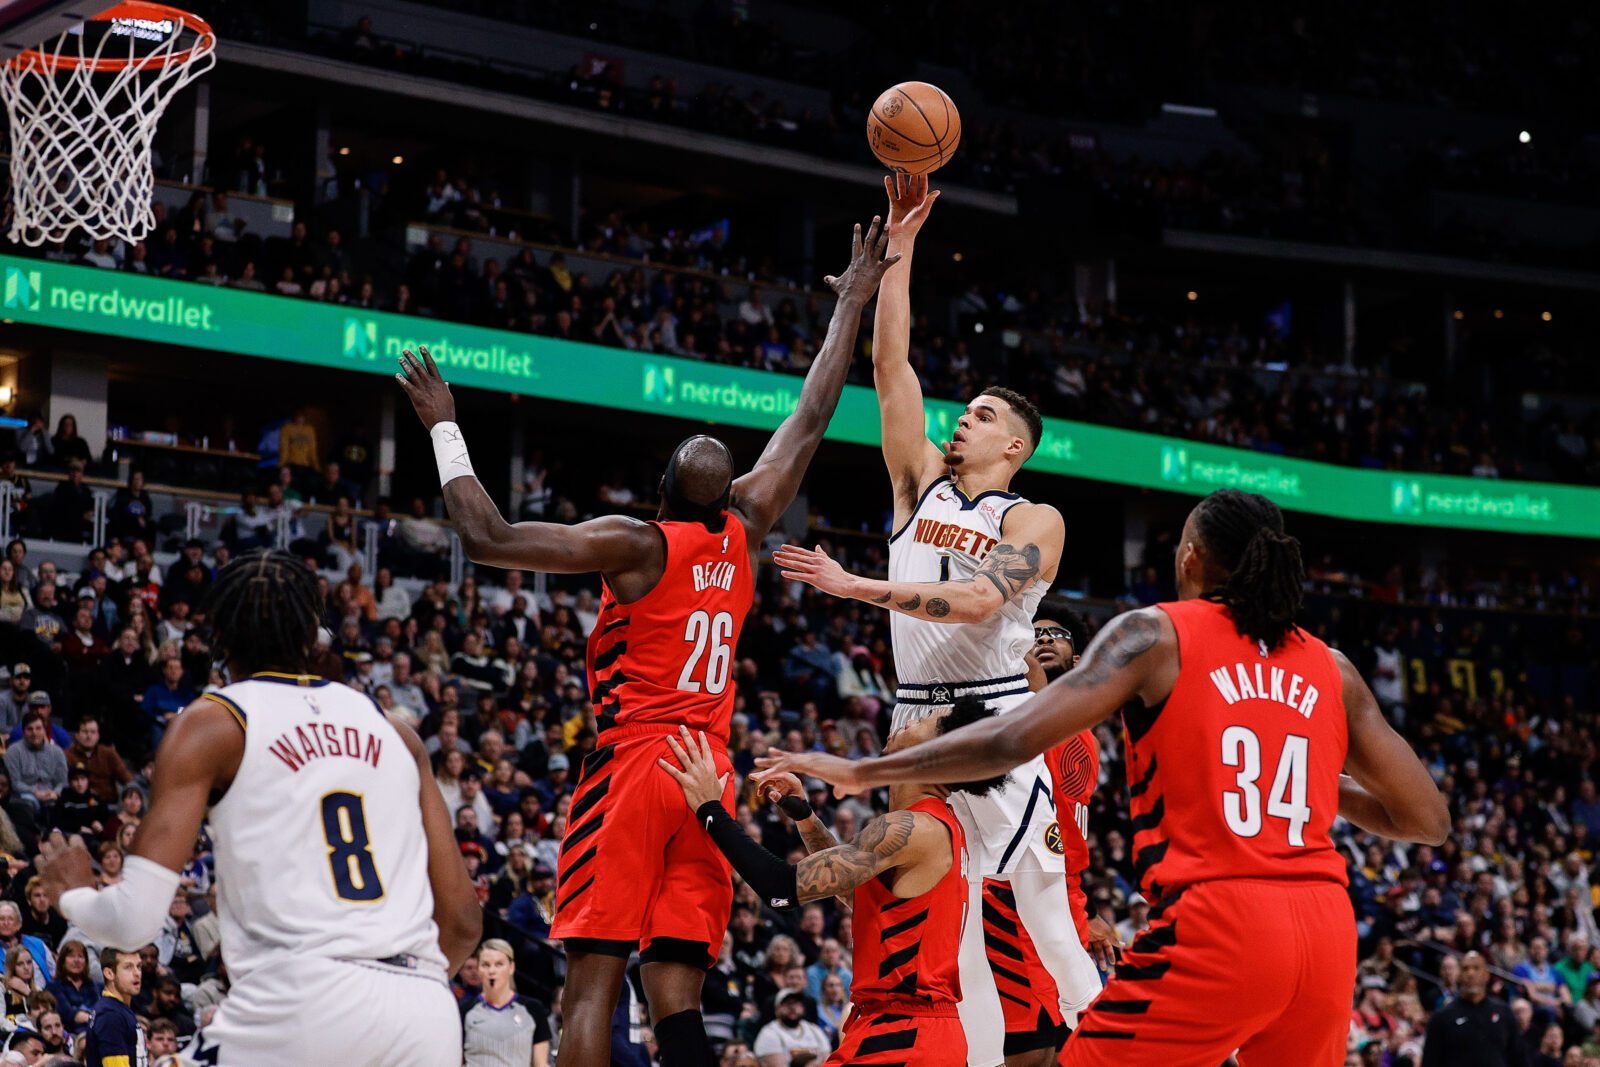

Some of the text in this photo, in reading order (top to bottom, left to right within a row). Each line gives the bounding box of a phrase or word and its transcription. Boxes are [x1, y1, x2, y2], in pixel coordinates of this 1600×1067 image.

[51, 286, 212, 331] nerdwallet
[681, 381, 800, 415] nerdwall
[913, 518, 999, 561] NUGGETS
[692, 561, 736, 592] REATH
[939, 554, 951, 582] 1
[676, 609, 733, 694] 26
[1209, 662, 1320, 719] WALKER
[268, 723, 382, 773] WATSON
[1220, 725, 1312, 847] 34
[319, 788, 386, 904] 8
